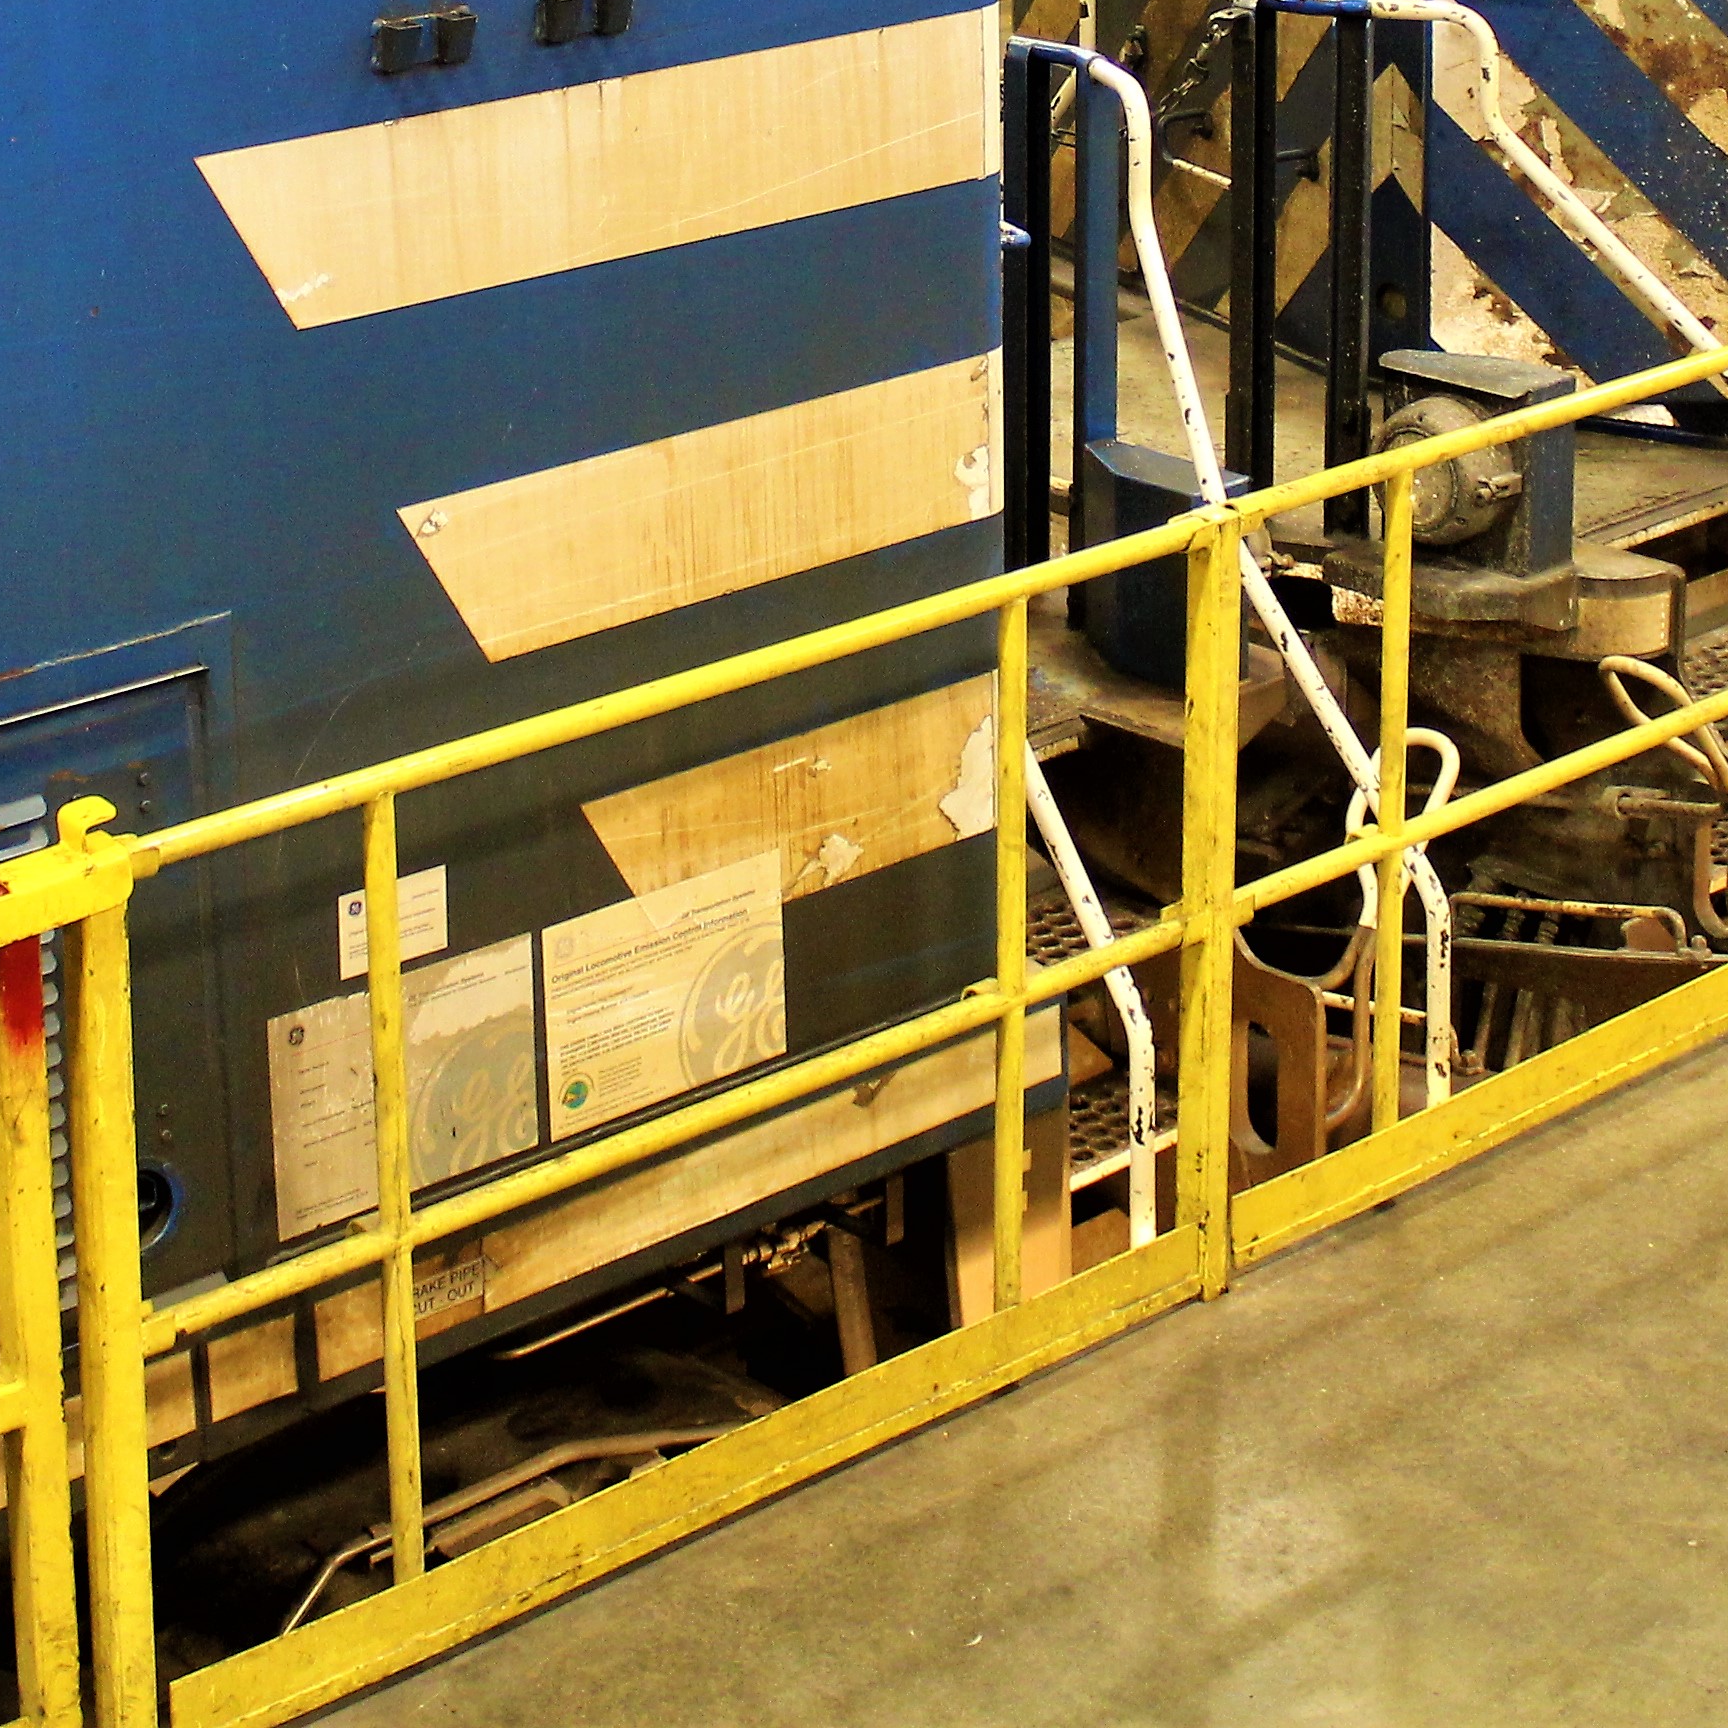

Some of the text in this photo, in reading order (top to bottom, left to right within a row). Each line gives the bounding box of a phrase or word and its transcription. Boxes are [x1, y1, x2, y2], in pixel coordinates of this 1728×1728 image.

[551, 964, 585, 985] Original
[585, 949, 633, 972] Locomotive
[634, 935, 672, 955] Emission
[673, 923, 702, 941] Control
[703, 908, 748, 930] Information
[413, 1262, 480, 1299] RAKE PIPE
[414, 1280, 475, 1315] UT OUT
